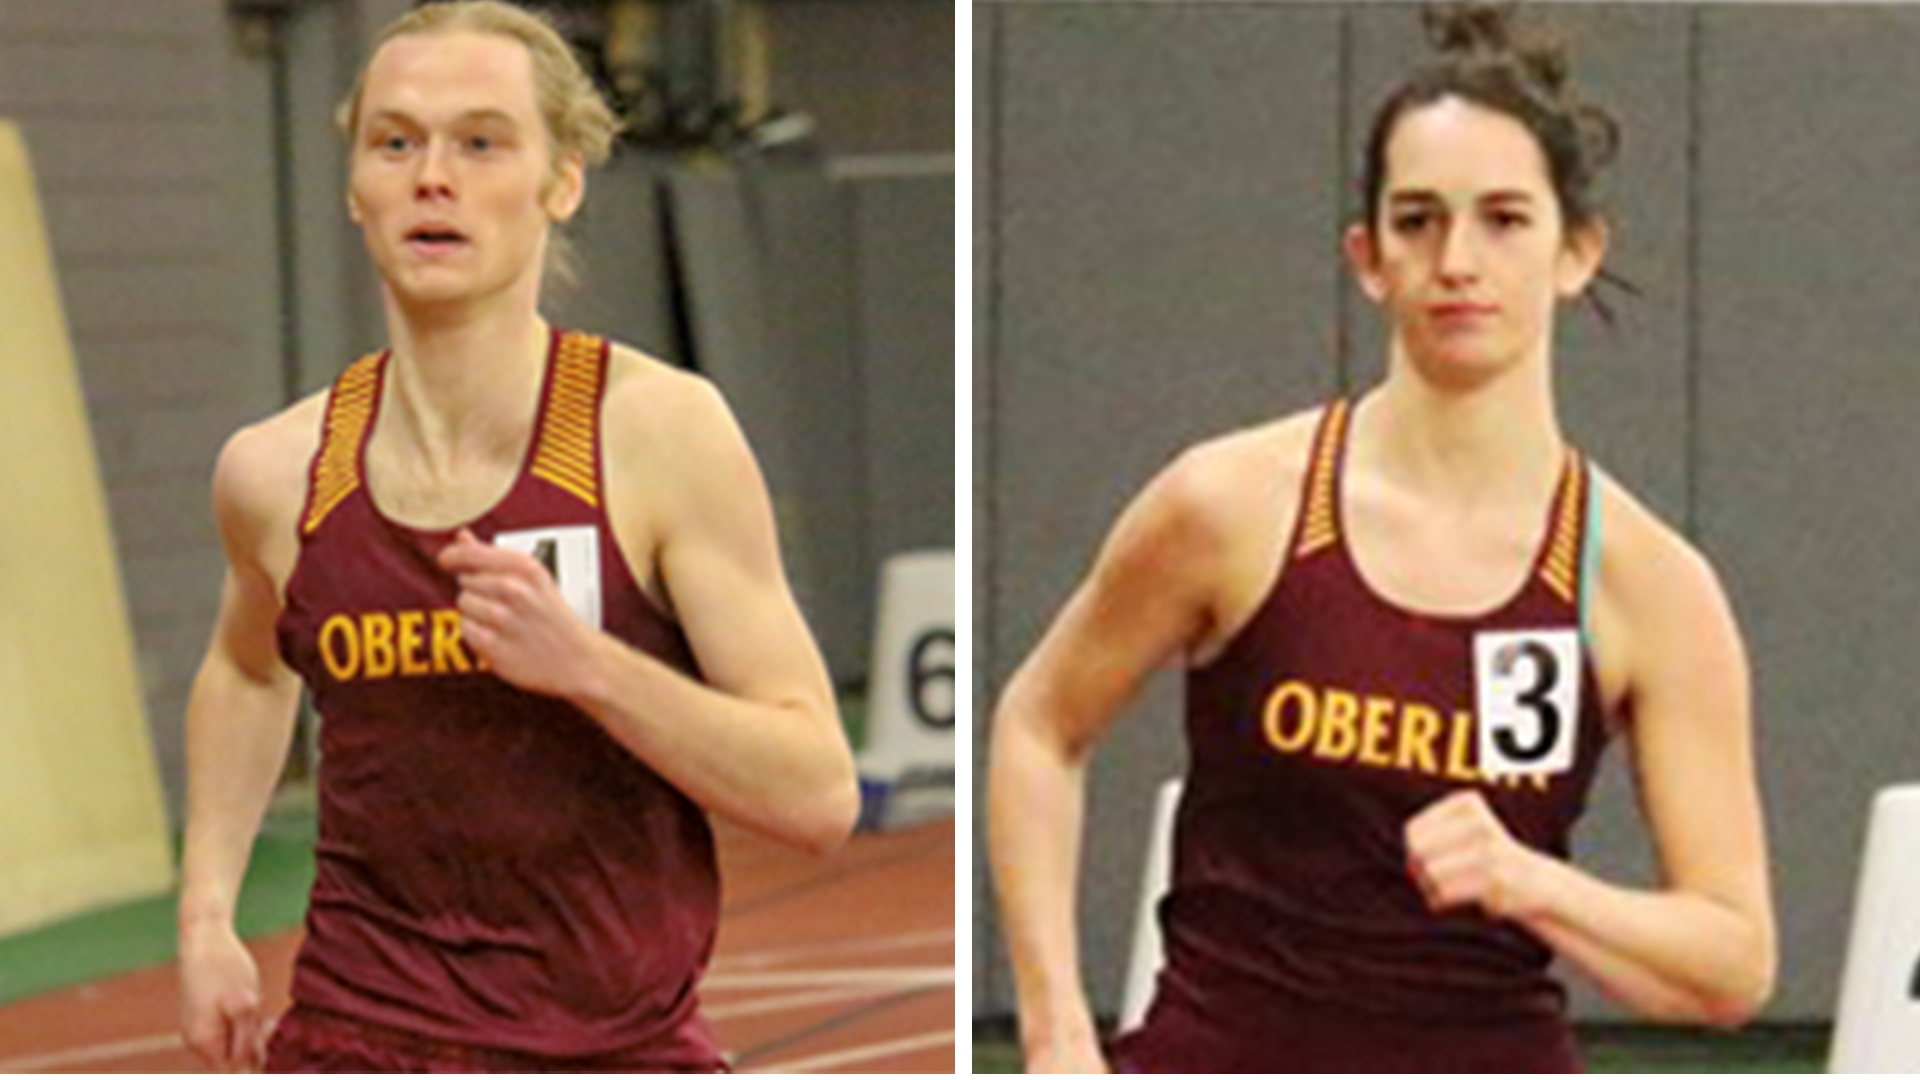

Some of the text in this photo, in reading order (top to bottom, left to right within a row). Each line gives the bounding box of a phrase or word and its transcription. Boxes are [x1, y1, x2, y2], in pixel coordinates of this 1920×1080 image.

[319, 610, 493, 681] OBER
[909, 628, 955, 731] 6
[1264, 680, 1548, 791] OBERL
[1492, 639, 1561, 763] 3
